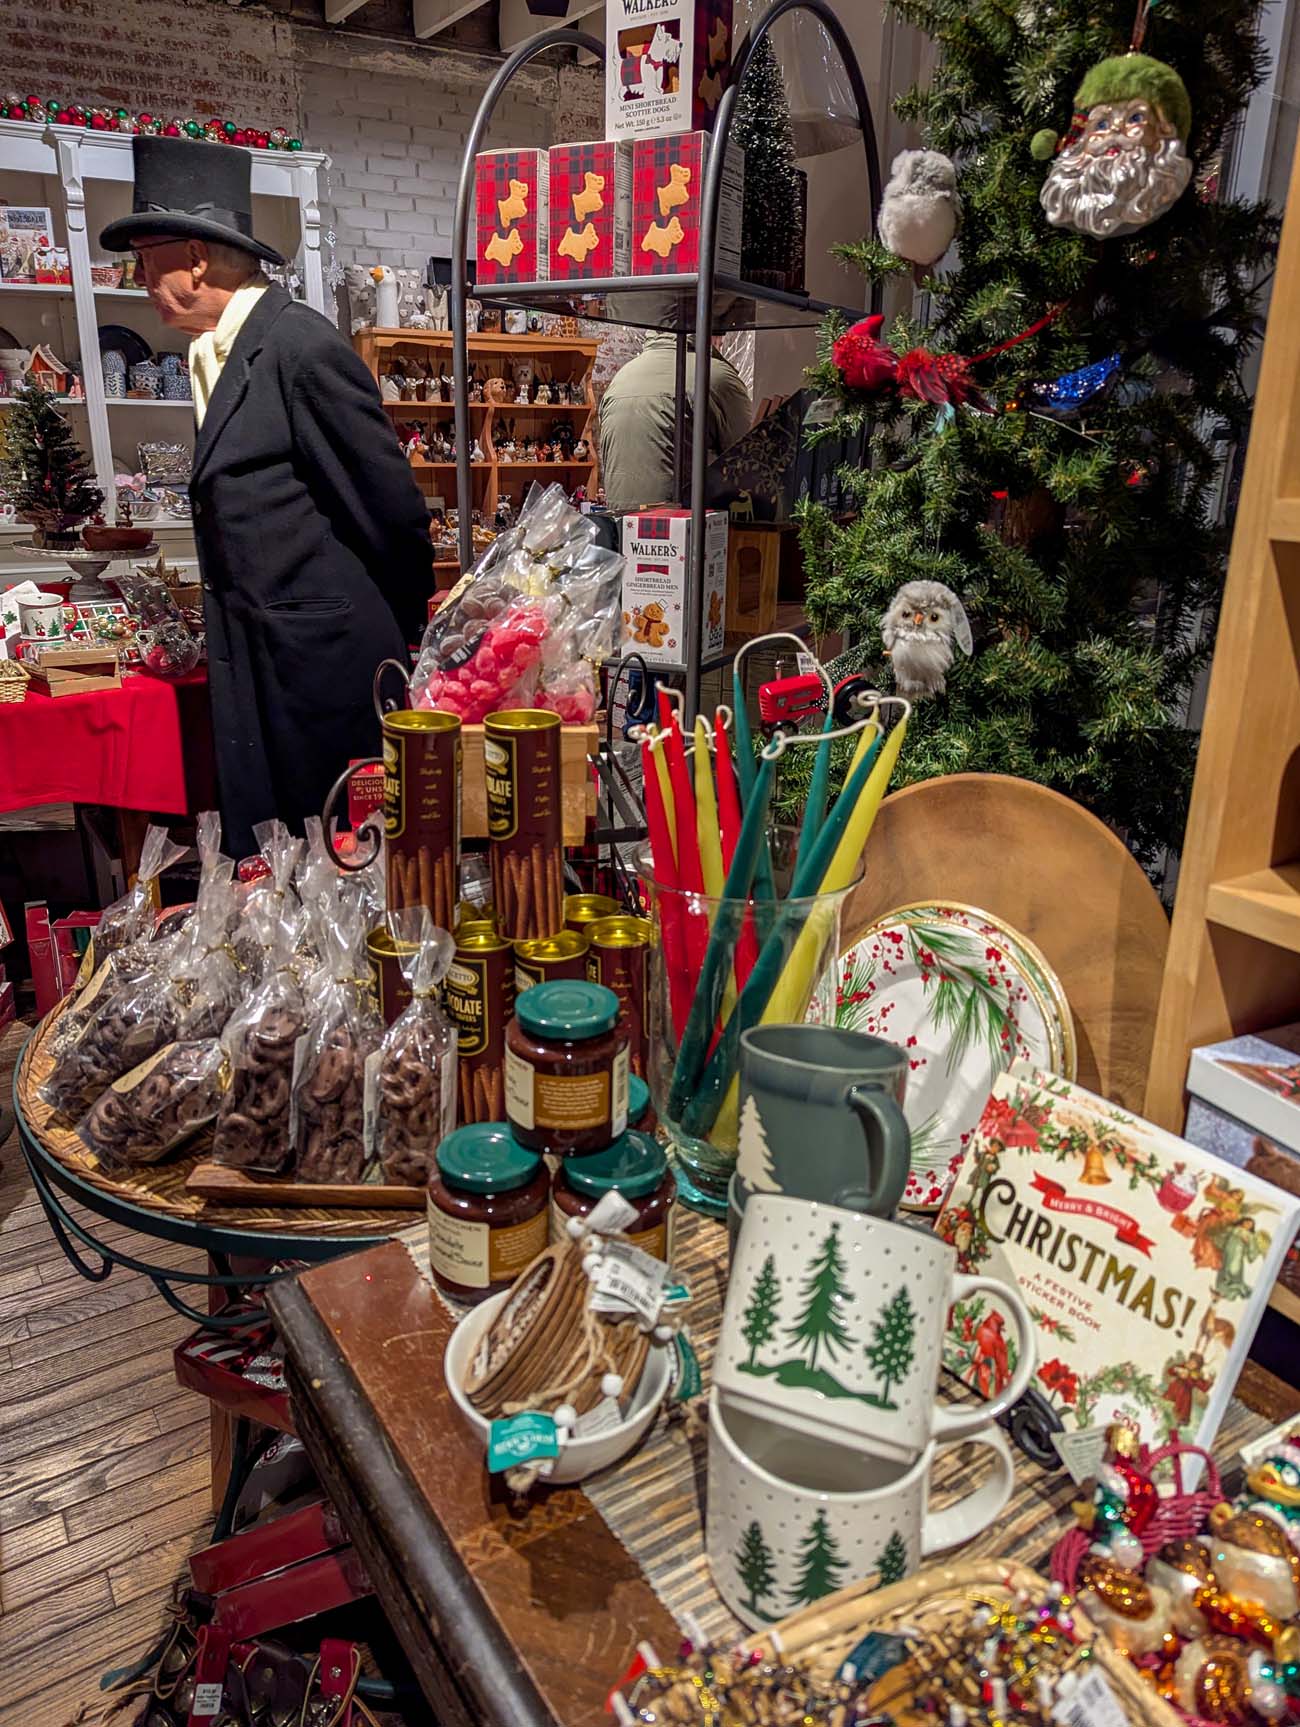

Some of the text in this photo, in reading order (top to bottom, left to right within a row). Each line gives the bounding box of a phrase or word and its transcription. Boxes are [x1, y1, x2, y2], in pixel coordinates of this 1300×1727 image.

[622, 0, 679, 15] WALKER
[619, 97, 677, 112] MINI SHORTBREAD
[625, 105, 670, 118] SCOTTIE DOGS
[630, 542, 678, 558] WALKER'S
[351, 778, 385, 787] DELICIOU
[1049, 1197, 1134, 1230] MERRY & BRIGHT
[978, 1177, 1198, 1339] CHRISTMAS!
[1033, 1272, 1094, 1313] A FESTIVE
[1016, 1275, 1102, 1332] STICKER BOOK
